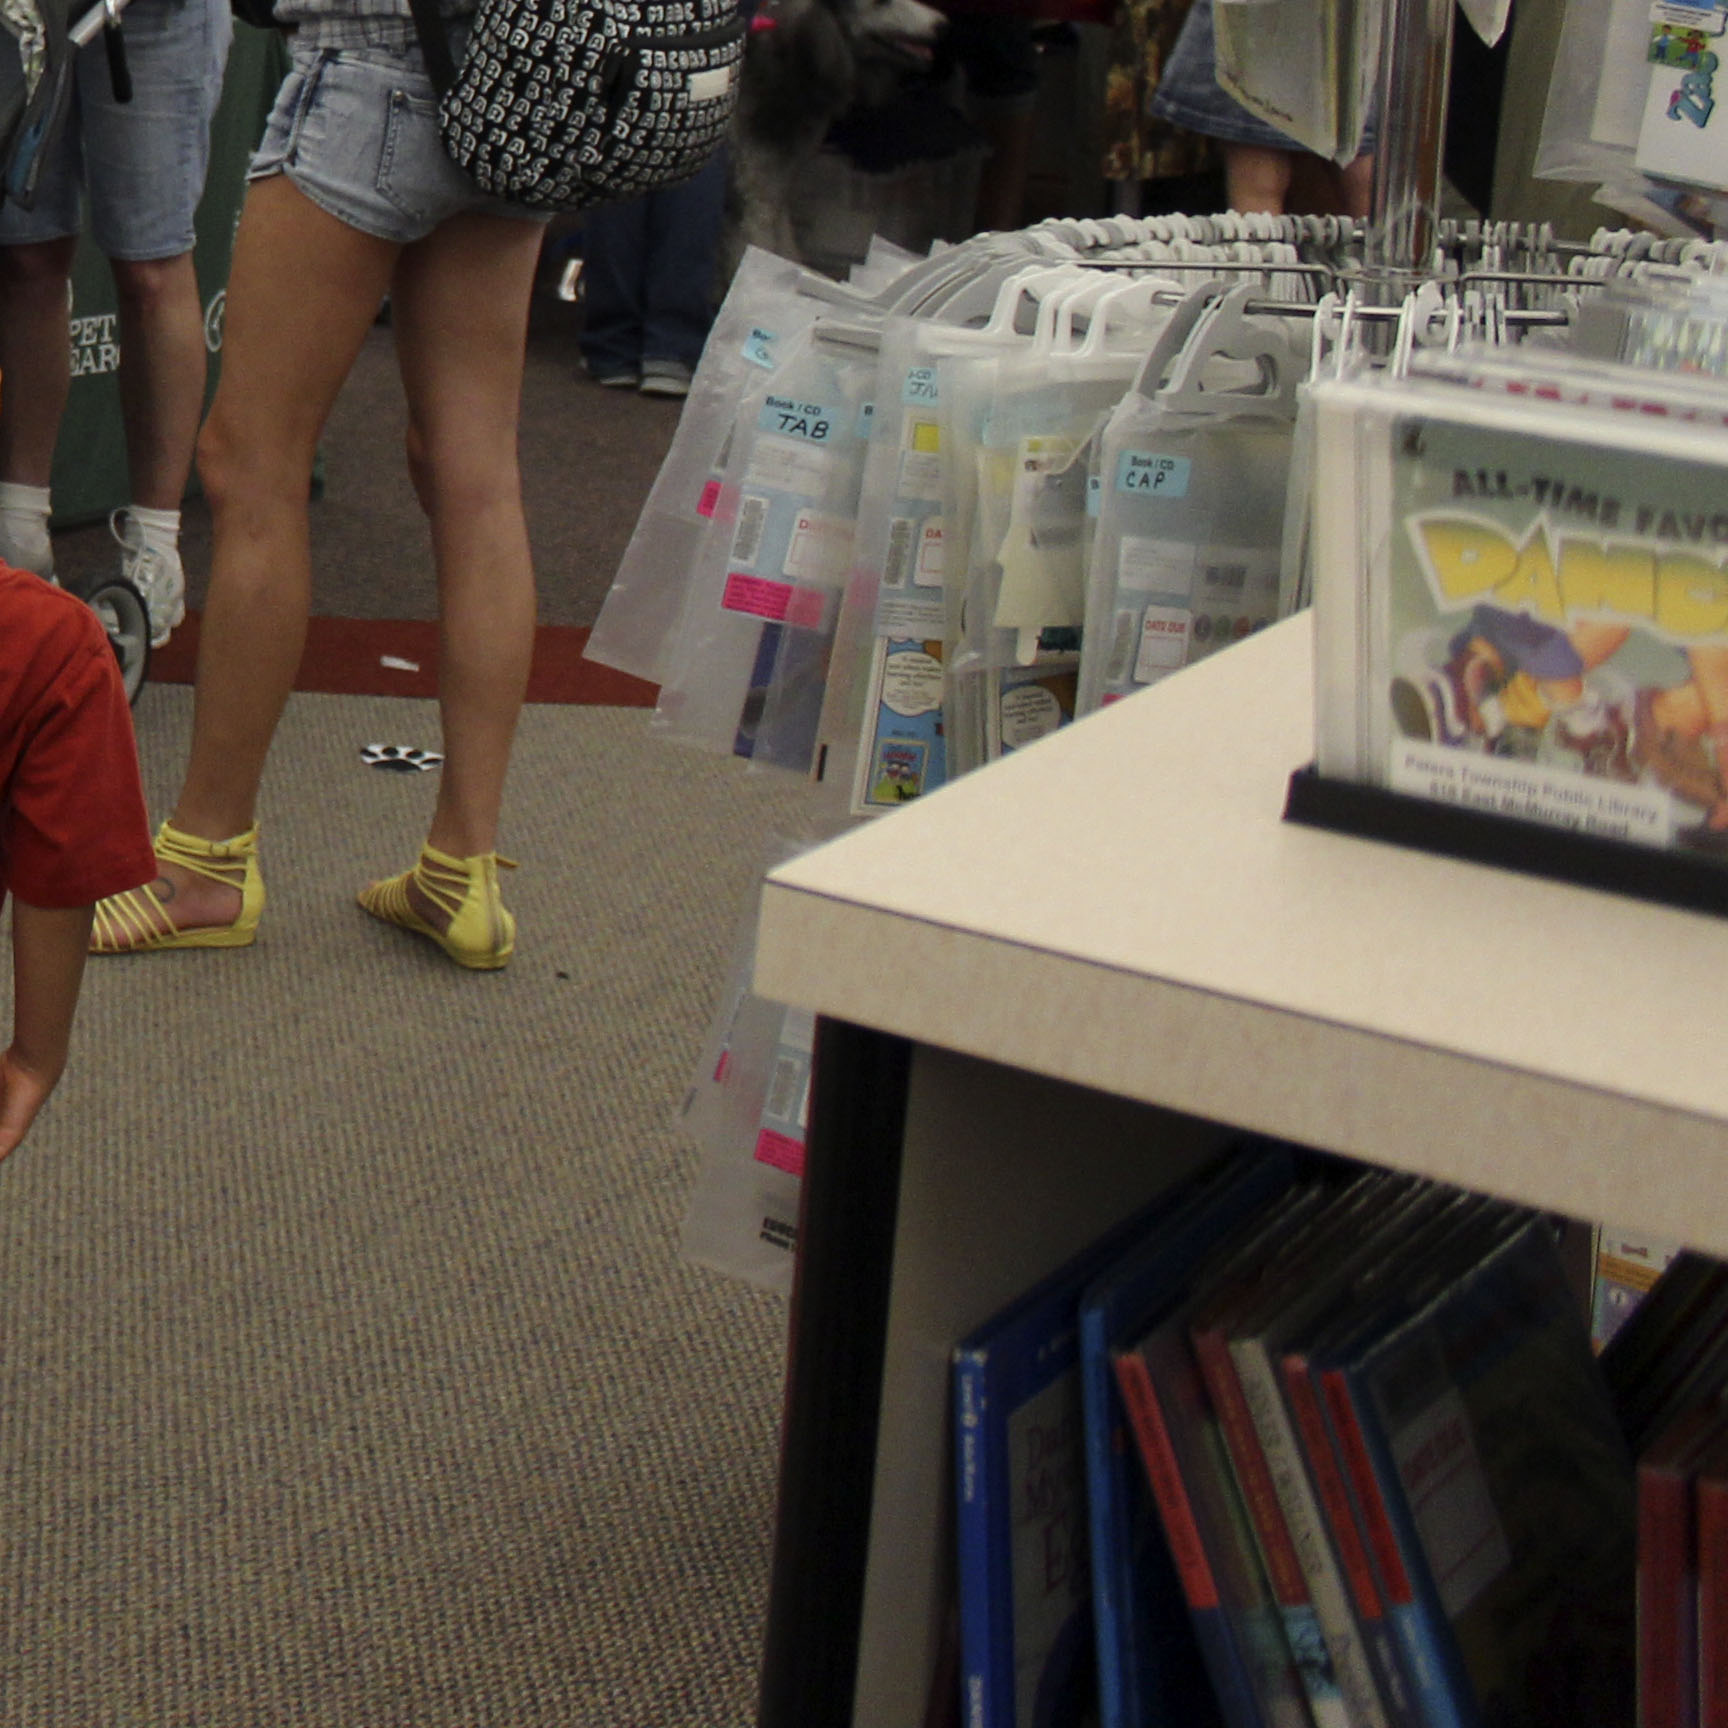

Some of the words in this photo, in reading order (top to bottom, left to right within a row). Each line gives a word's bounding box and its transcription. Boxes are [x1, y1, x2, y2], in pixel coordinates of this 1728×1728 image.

[68, 314, 117, 347] PET
[70, 343, 121, 378] EAR
[766, 395, 794, 411] Book
[804, 404, 822, 417] CD
[778, 413, 830, 441] TAB
[1131, 455, 1153, 468] Book
[1160, 458, 1174, 471] CD
[1125, 471, 1166, 490] CAP
[1452, 469, 1621, 529] ALL-TIME
[1145, 619, 1167, 632] DATE
[1168, 621, 1187, 634] DUE
[1462, 767, 1537, 796] Township
[1598, 796, 1657, 824] Library
